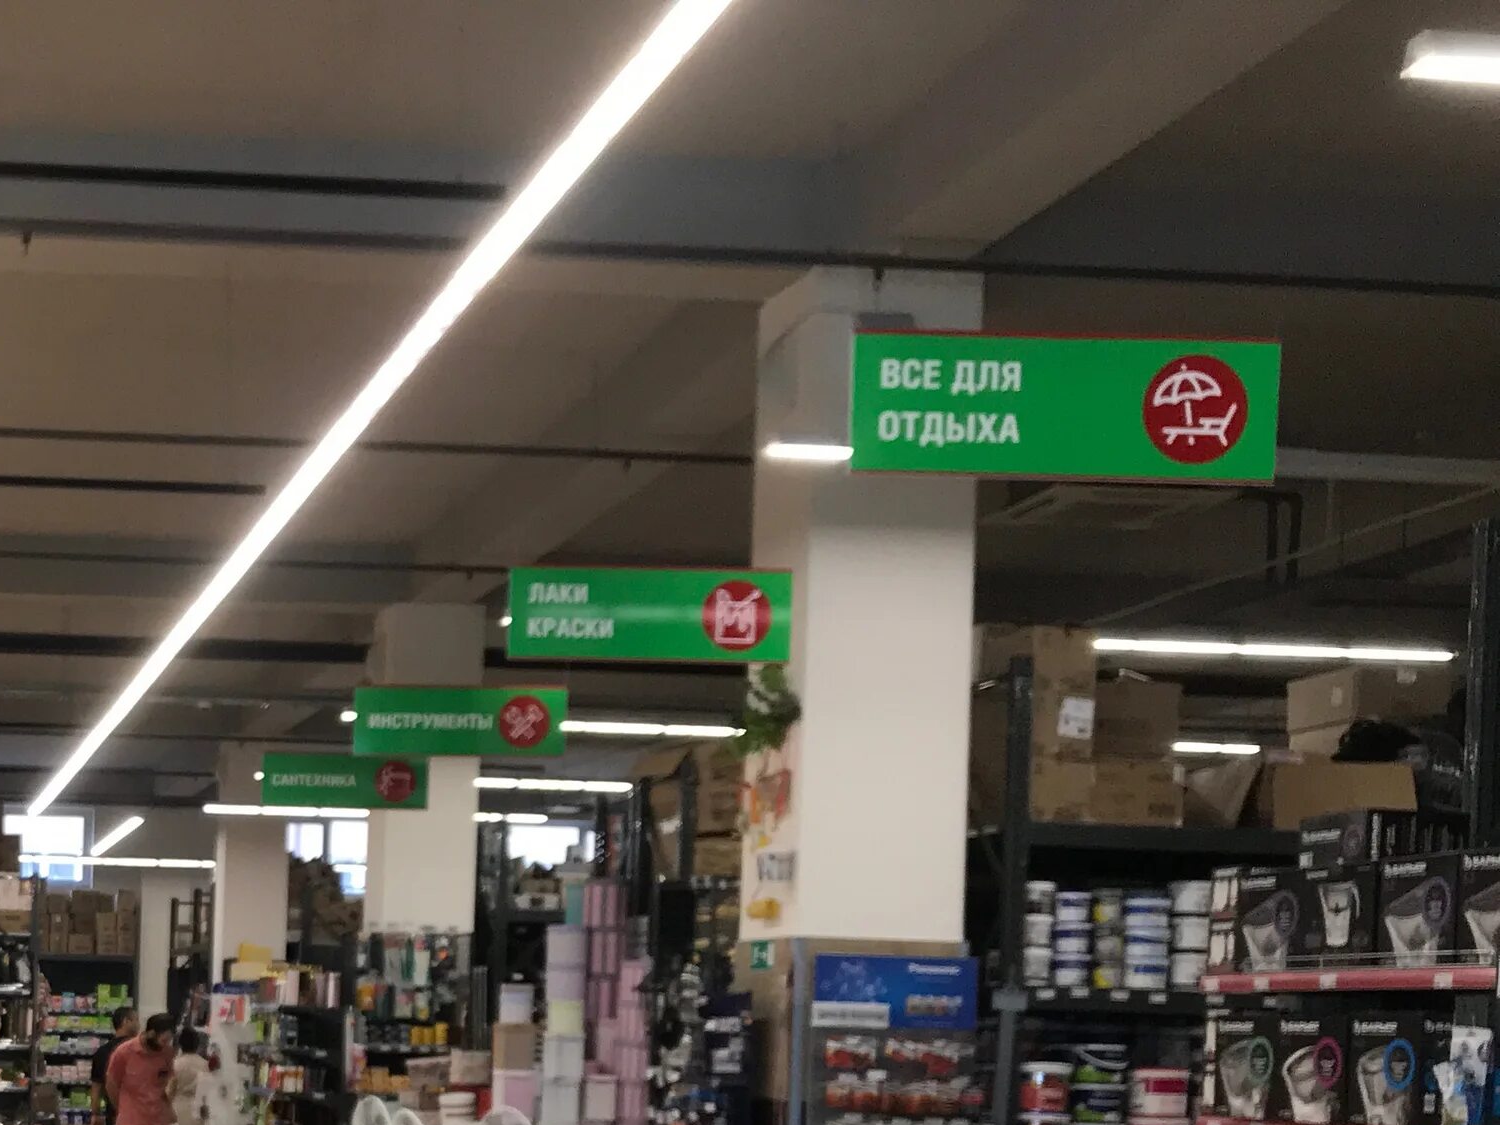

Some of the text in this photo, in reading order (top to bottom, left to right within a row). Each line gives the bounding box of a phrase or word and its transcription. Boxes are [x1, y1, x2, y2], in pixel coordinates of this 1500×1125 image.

[879, 357, 1023, 396] ВСЕ ДЛЯ
[876, 409, 1021, 448] ОТДЫХА
[526, 581, 590, 606] ЛАКИ
[526, 616, 615, 640] КРАСКИ
[367, 711, 494, 731] ИНСТРУМЕНТЫ
[270, 772, 357, 788] САНТЕХНИКА
